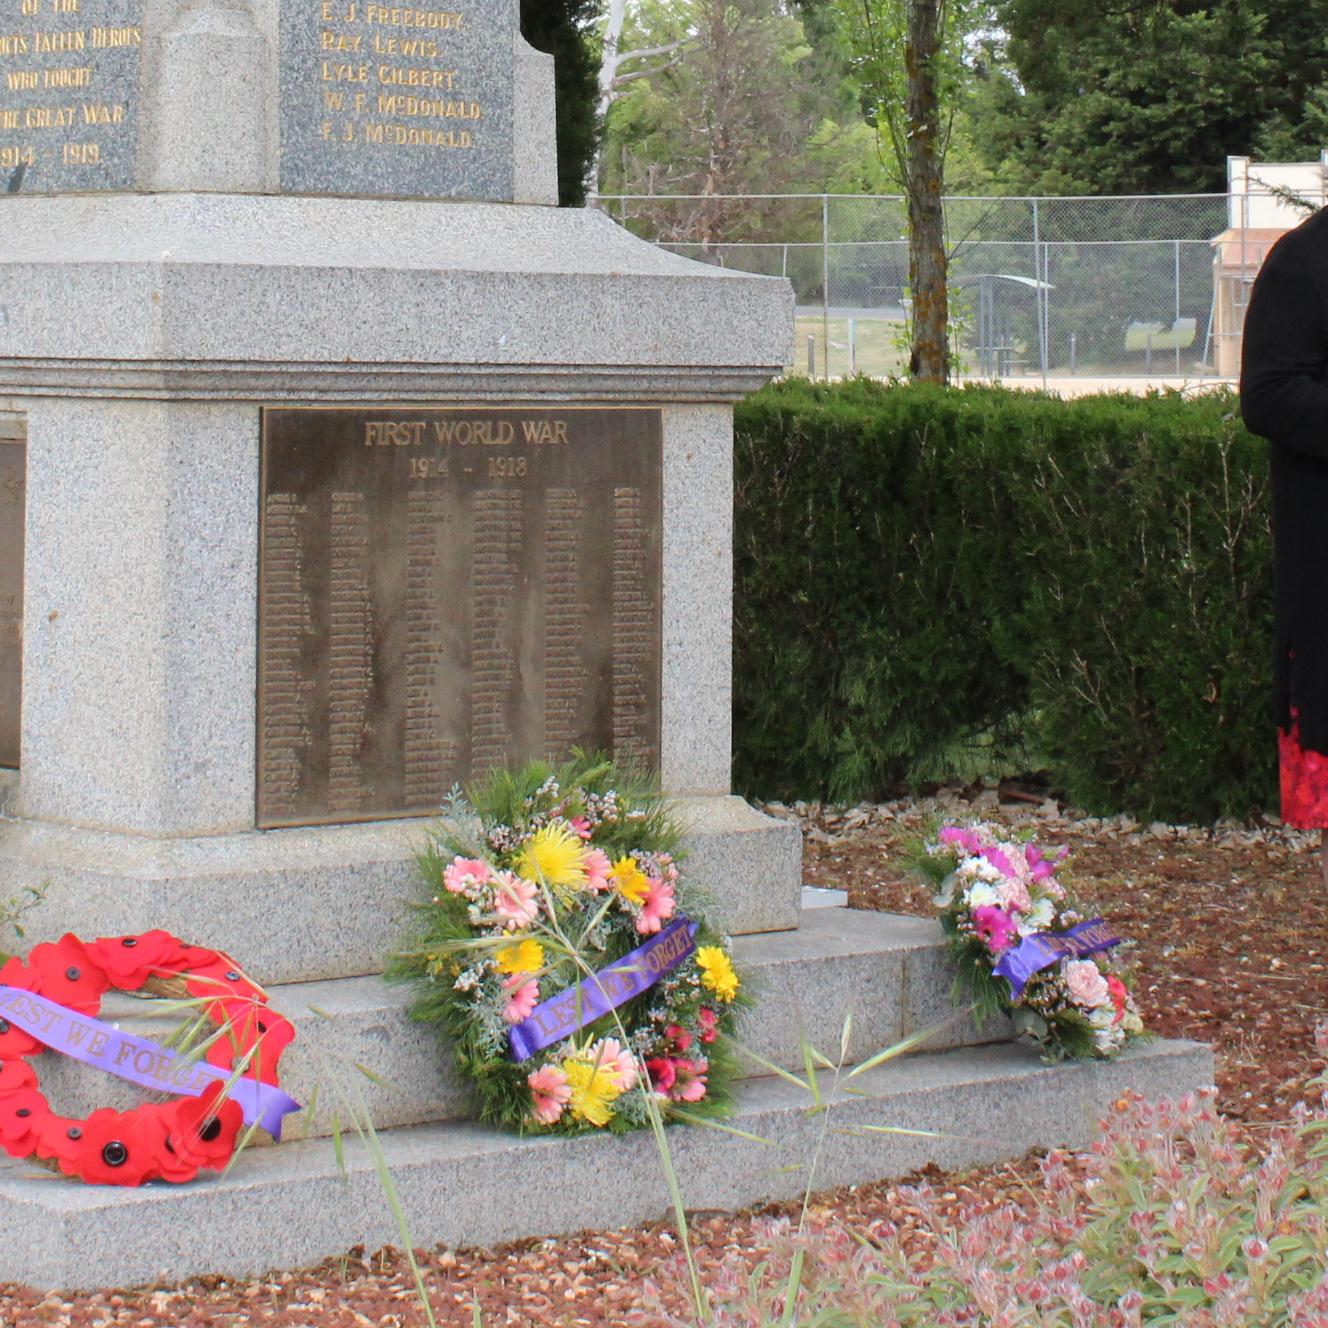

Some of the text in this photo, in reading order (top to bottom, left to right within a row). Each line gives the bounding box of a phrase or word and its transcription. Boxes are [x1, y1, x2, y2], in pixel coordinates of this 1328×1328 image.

[35, 30, 85, 53] FALLEN
[92, 25, 142, 49] HEROES
[7, 66, 93, 90] WHO FOUGHT
[322, 61, 369, 83] LYLE
[26, 106, 75, 129] GREAT
[82, 102, 124, 125] WAR
[365, 420, 569, 446] FIRST WORLD WAR
[409, 457, 449, 479] 1914
[487, 456, 527, 477] 1918
[64, 1022, 110, 1058] WE
[112, 1039, 219, 1091] FORGE
